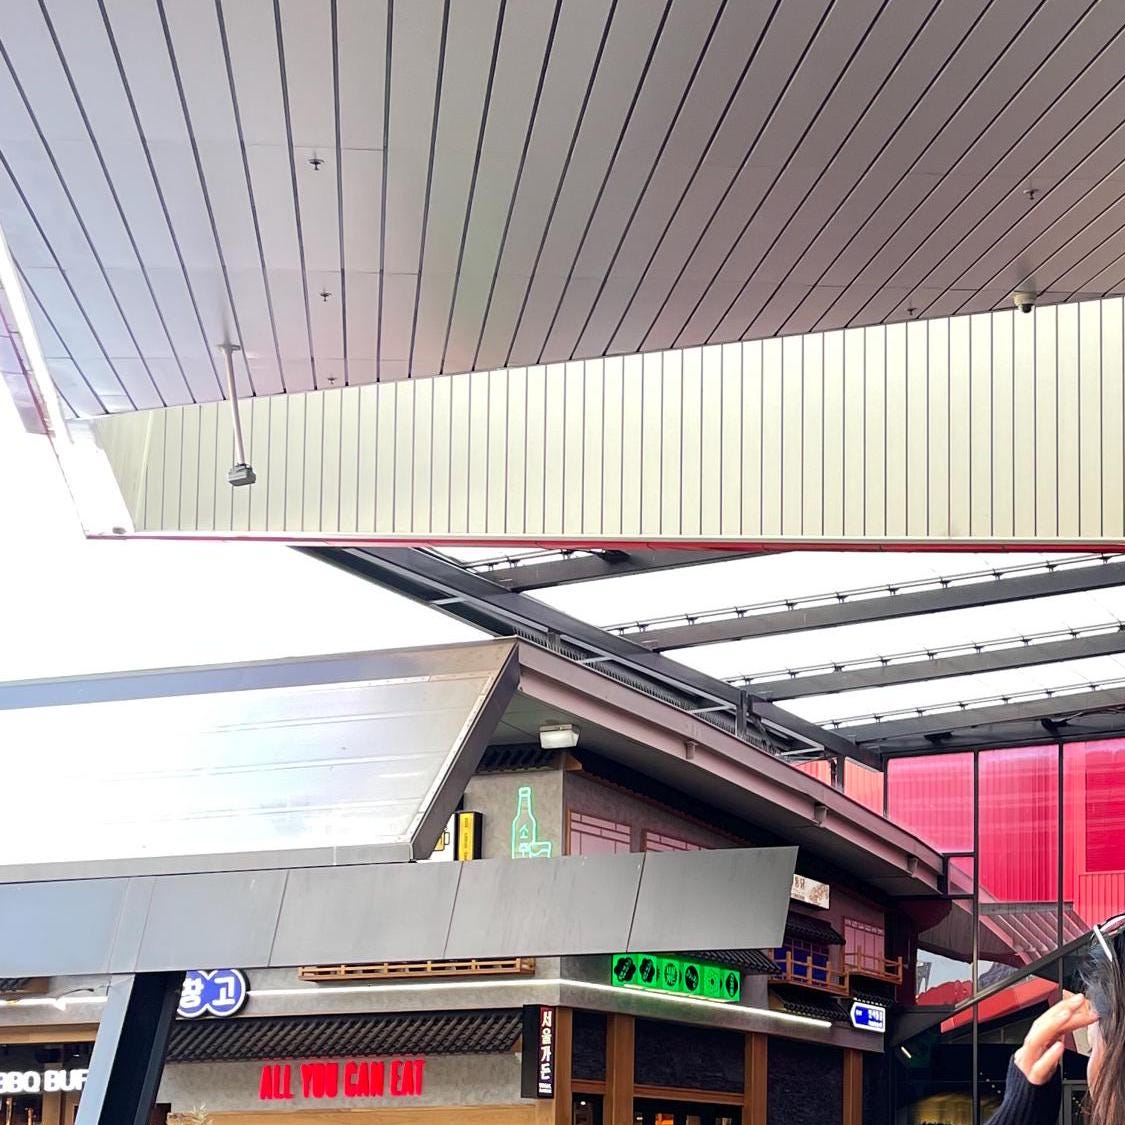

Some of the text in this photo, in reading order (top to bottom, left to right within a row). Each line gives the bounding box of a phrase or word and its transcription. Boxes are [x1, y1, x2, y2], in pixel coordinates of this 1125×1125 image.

[540, 1010, 553, 1080] 서울가든
[259, 1059, 425, 1100] ALL YOU CAN EAT
